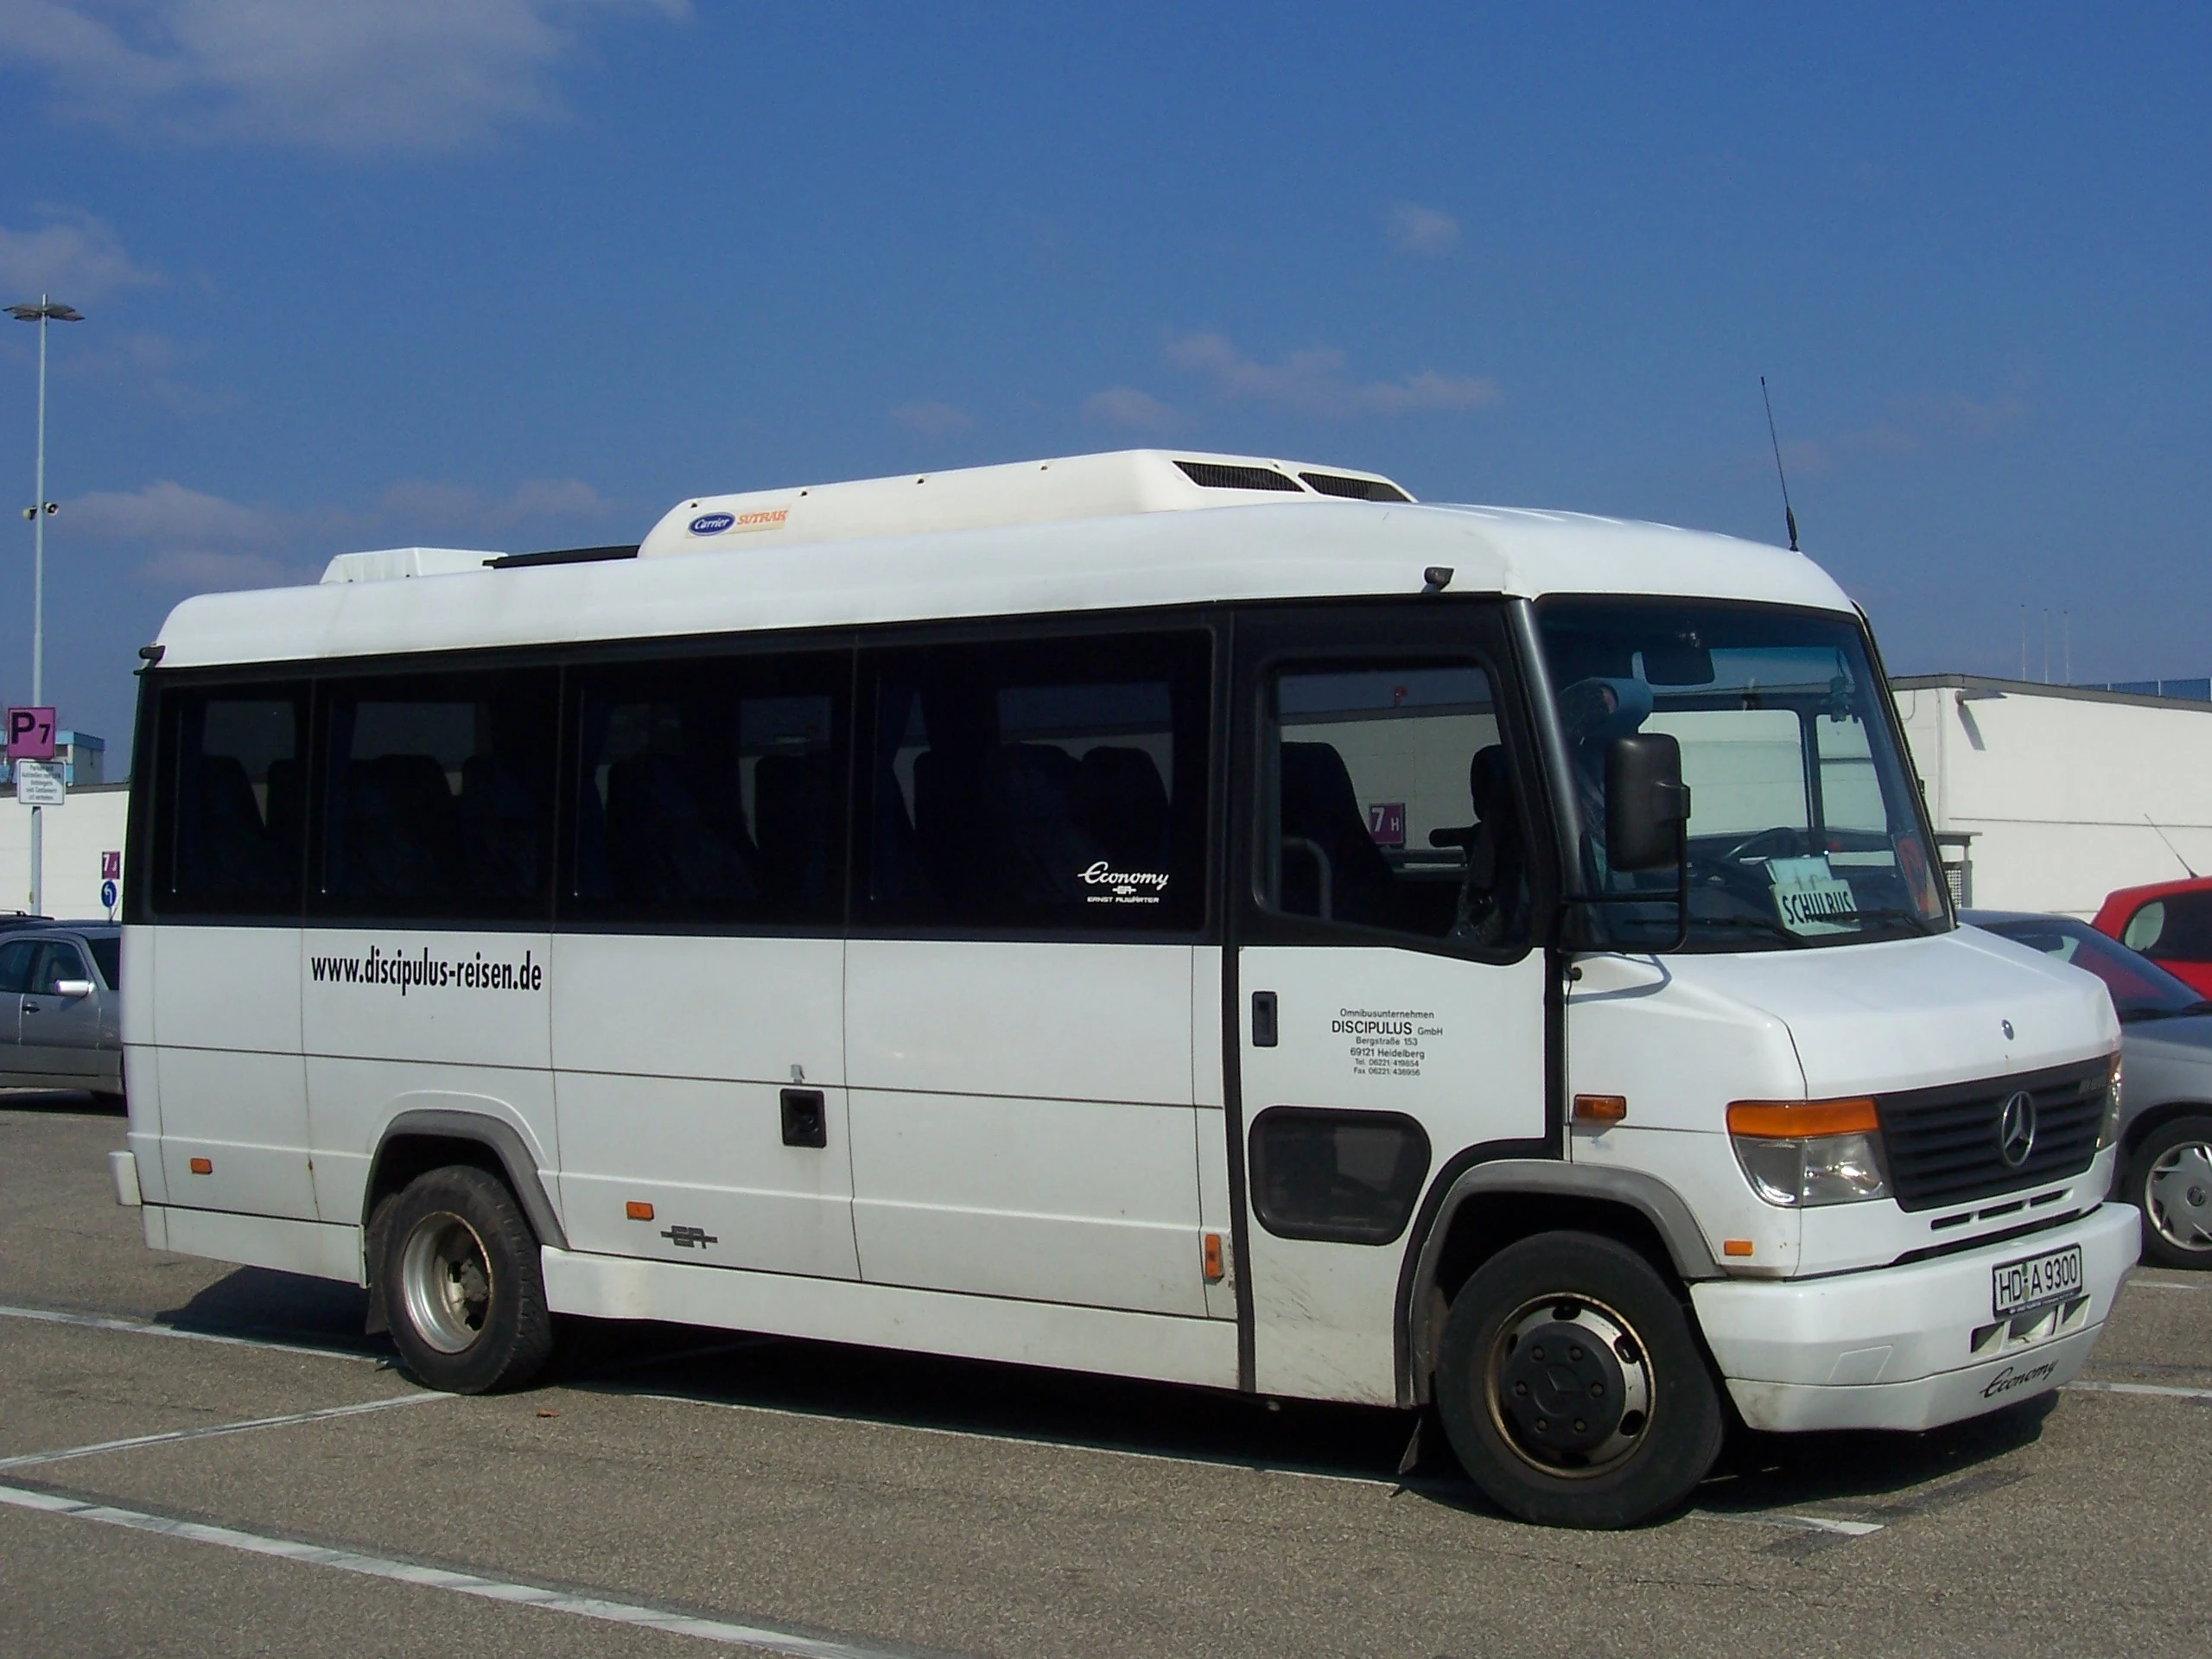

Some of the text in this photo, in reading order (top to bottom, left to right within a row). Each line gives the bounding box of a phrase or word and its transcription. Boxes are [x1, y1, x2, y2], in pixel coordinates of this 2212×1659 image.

[695, 510, 788, 530] Carrier SUTRAK
[1371, 807, 1384, 832] 7
[1077, 861, 1169, 891] Economy
[311, 945, 542, 996] www.discipulus-reisen.de
[1340, 1007, 1434, 1019] Omnibusunternehmen
[1332, 1020, 1443, 1035] DISCIPULUS GmbH
[1356, 1036, 1400, 1046] Bergstraße
[1350, 1047, 1425, 1060] 69121 Heidelberg
[2044, 1253, 2077, 1291] 9300
[1979, 1359, 2058, 1398] Economy
